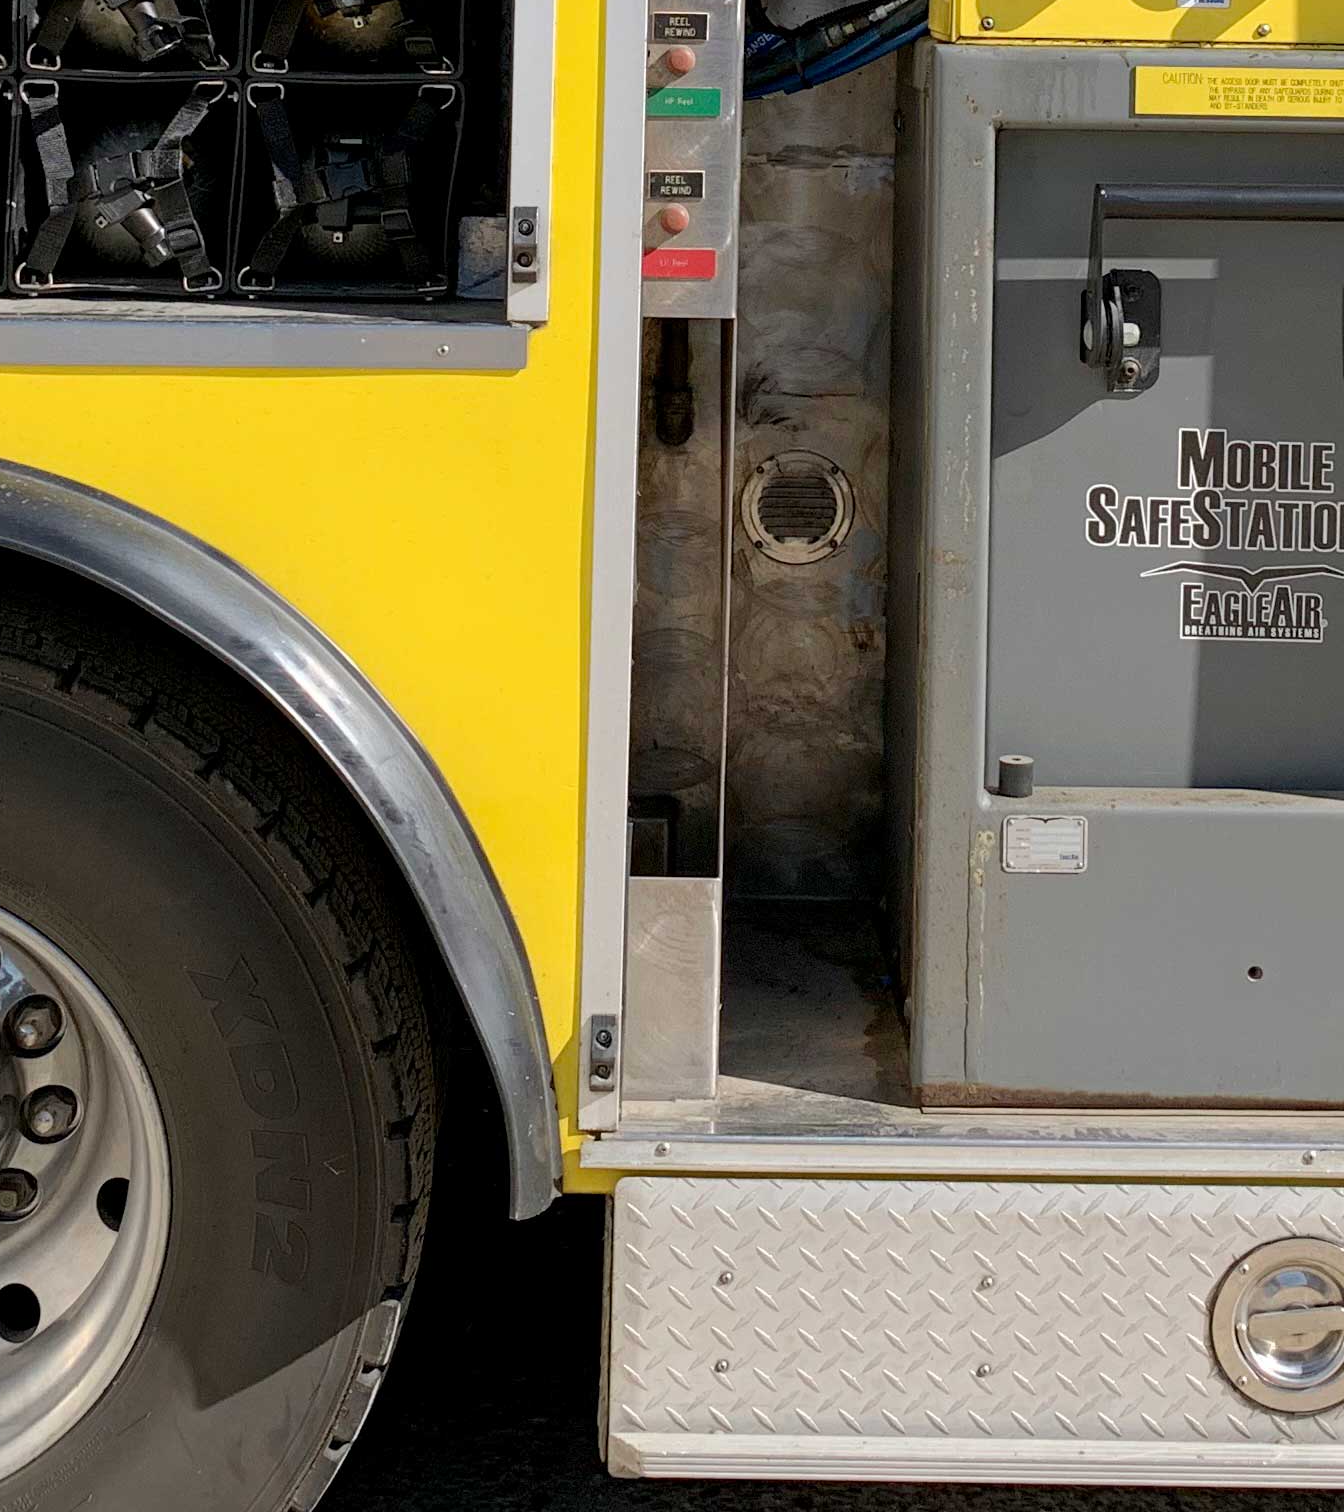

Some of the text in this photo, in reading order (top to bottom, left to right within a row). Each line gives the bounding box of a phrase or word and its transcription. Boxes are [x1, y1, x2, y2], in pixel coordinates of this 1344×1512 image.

[669, 17, 691, 27] REEL
[664, 27, 697, 38] REWIND
[665, 175, 687, 185] REEL
[660, 186, 692, 196] REWIND
[1178, 428, 1335, 493] MOBILE
[1184, 625, 1320, 639] BREATHING AIR SYSTEMS
